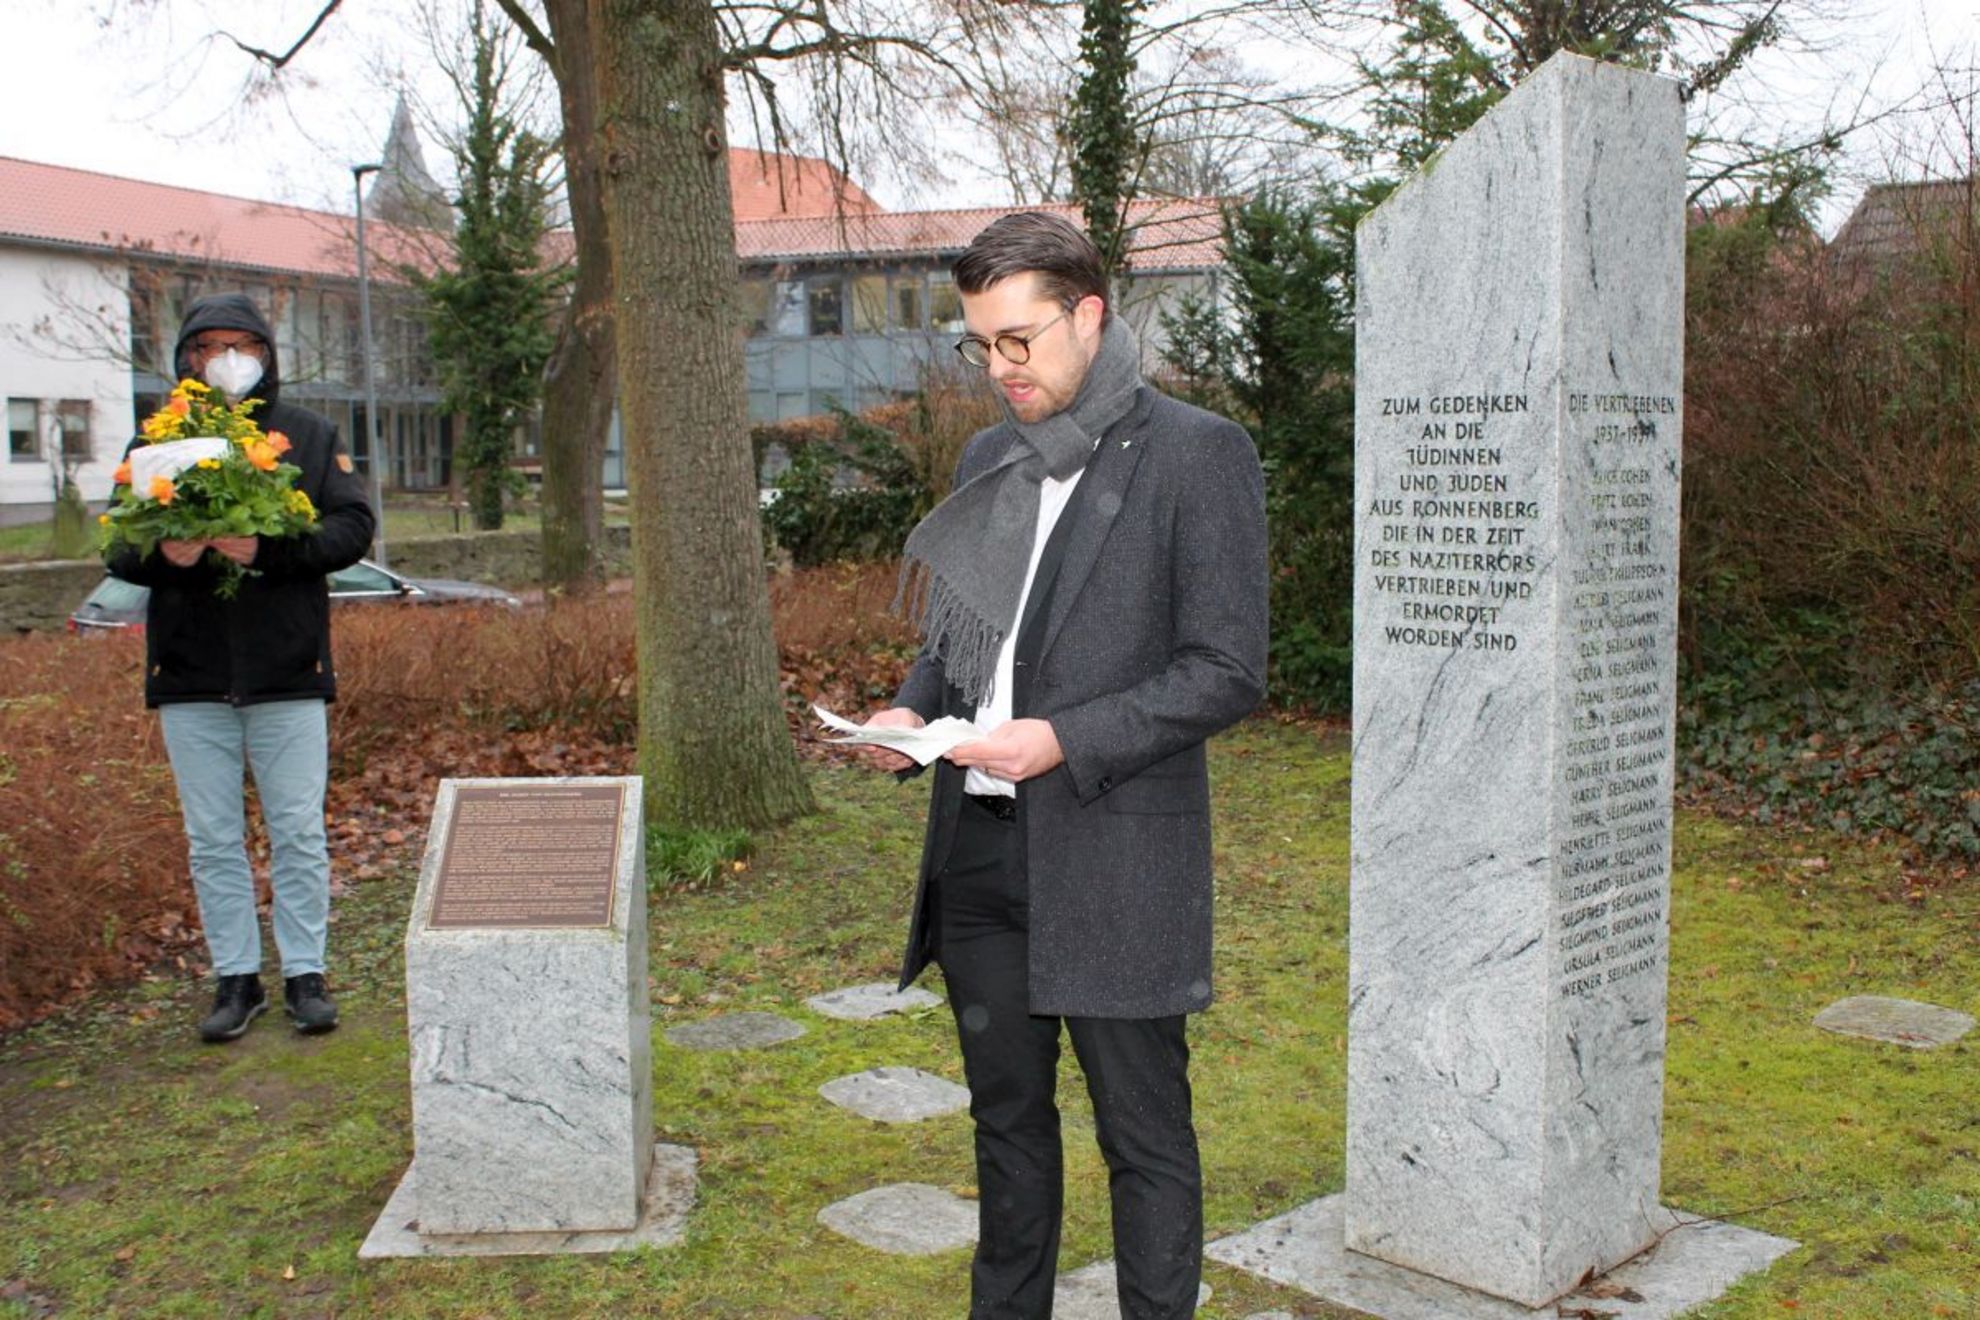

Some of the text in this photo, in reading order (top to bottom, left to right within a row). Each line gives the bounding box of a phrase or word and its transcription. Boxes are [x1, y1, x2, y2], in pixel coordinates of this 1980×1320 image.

[1382, 395, 1528, 416] ZUM GEDENKEN
[1595, 393, 1675, 414] VERTRIEBENEN
[1421, 422, 1484, 440] AN DIE
[1407, 445, 1501, 465] JÜDINNEN
[1400, 474, 1507, 492] UND JUDEN
[1369, 500, 1539, 520] AUS RONNENBERG
[1382, 525, 1525, 546] DIE IN DER ZEIT
[1372, 550, 1536, 573] DES NAZITERRORS
[1375, 575, 1532, 599] VERTRIEBEN UND
[1403, 602, 1500, 625] ERMORDET
[1386, 626, 1518, 652] WORDEN SIND
